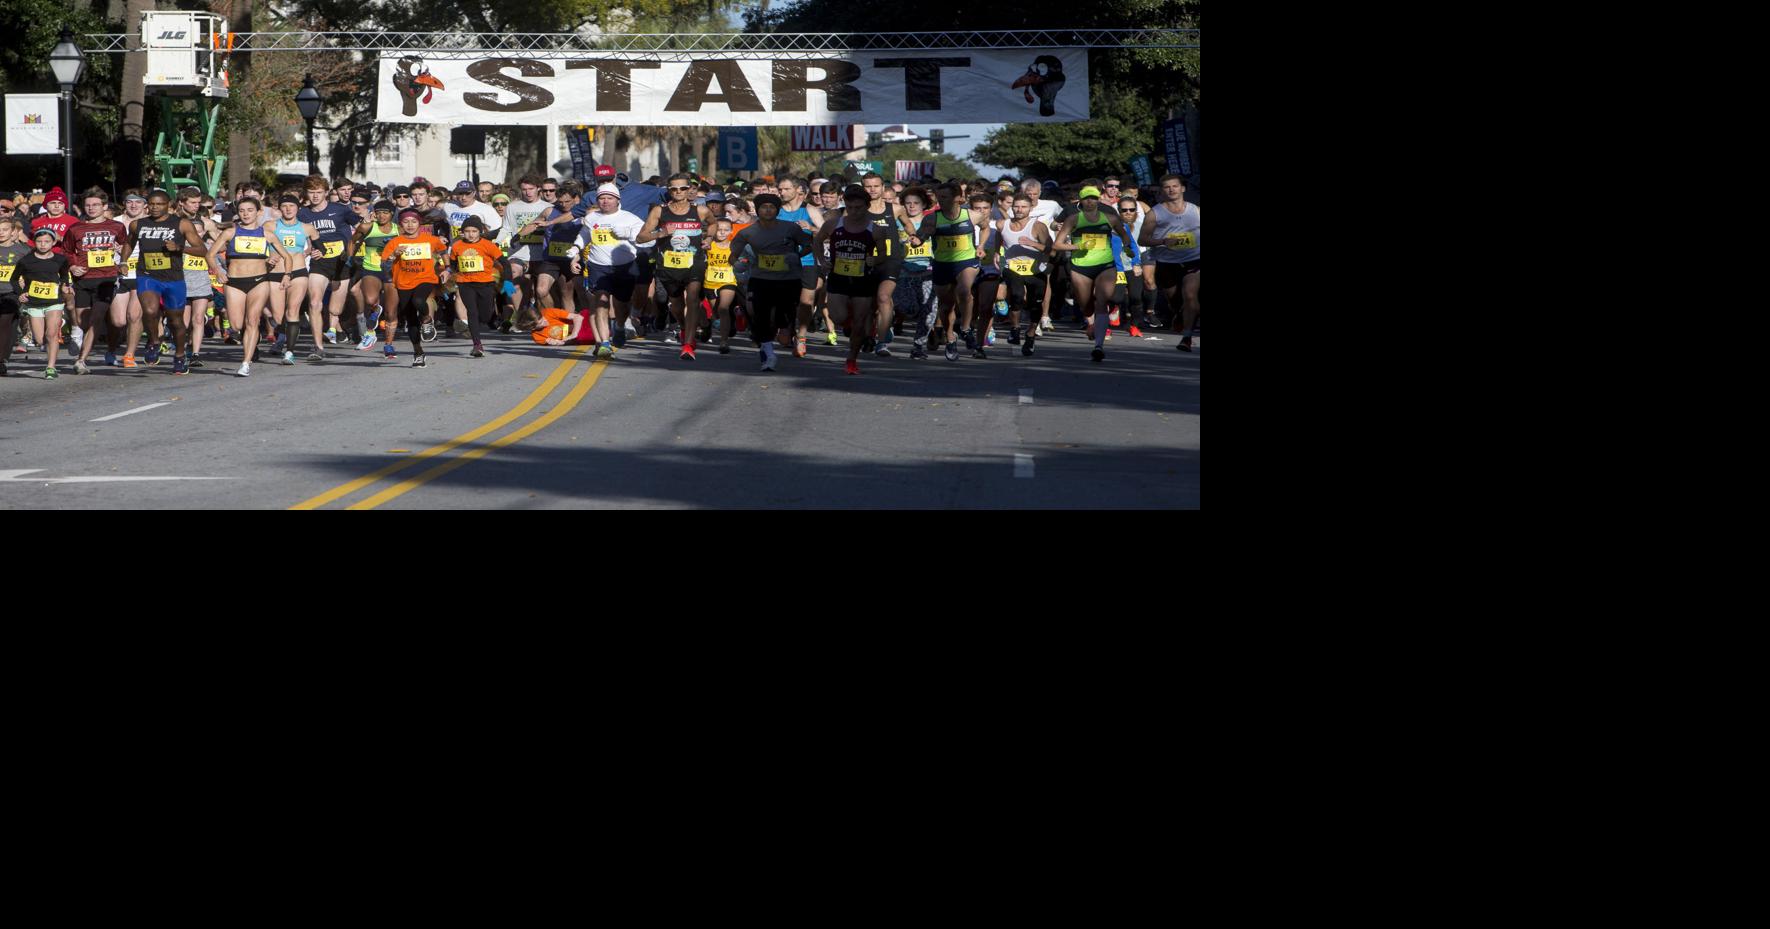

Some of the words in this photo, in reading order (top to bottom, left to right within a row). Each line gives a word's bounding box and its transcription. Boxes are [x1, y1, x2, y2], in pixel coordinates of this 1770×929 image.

[157, 31, 187, 40] JLG
[463, 57, 971, 112] START
[794, 125, 851, 150] WALK
[727, 136, 748, 169] B
[897, 161, 934, 180] WALK
[82, 235, 116, 245] STATE
[598, 234, 607, 242] 51
[152, 258, 163, 266] 15
[671, 257, 681, 265] 45
[844, 264, 849, 272] 5
[1016, 264, 1027, 272] 25
[714, 271, 724, 279] 78
[34, 286, 50, 295] 873
